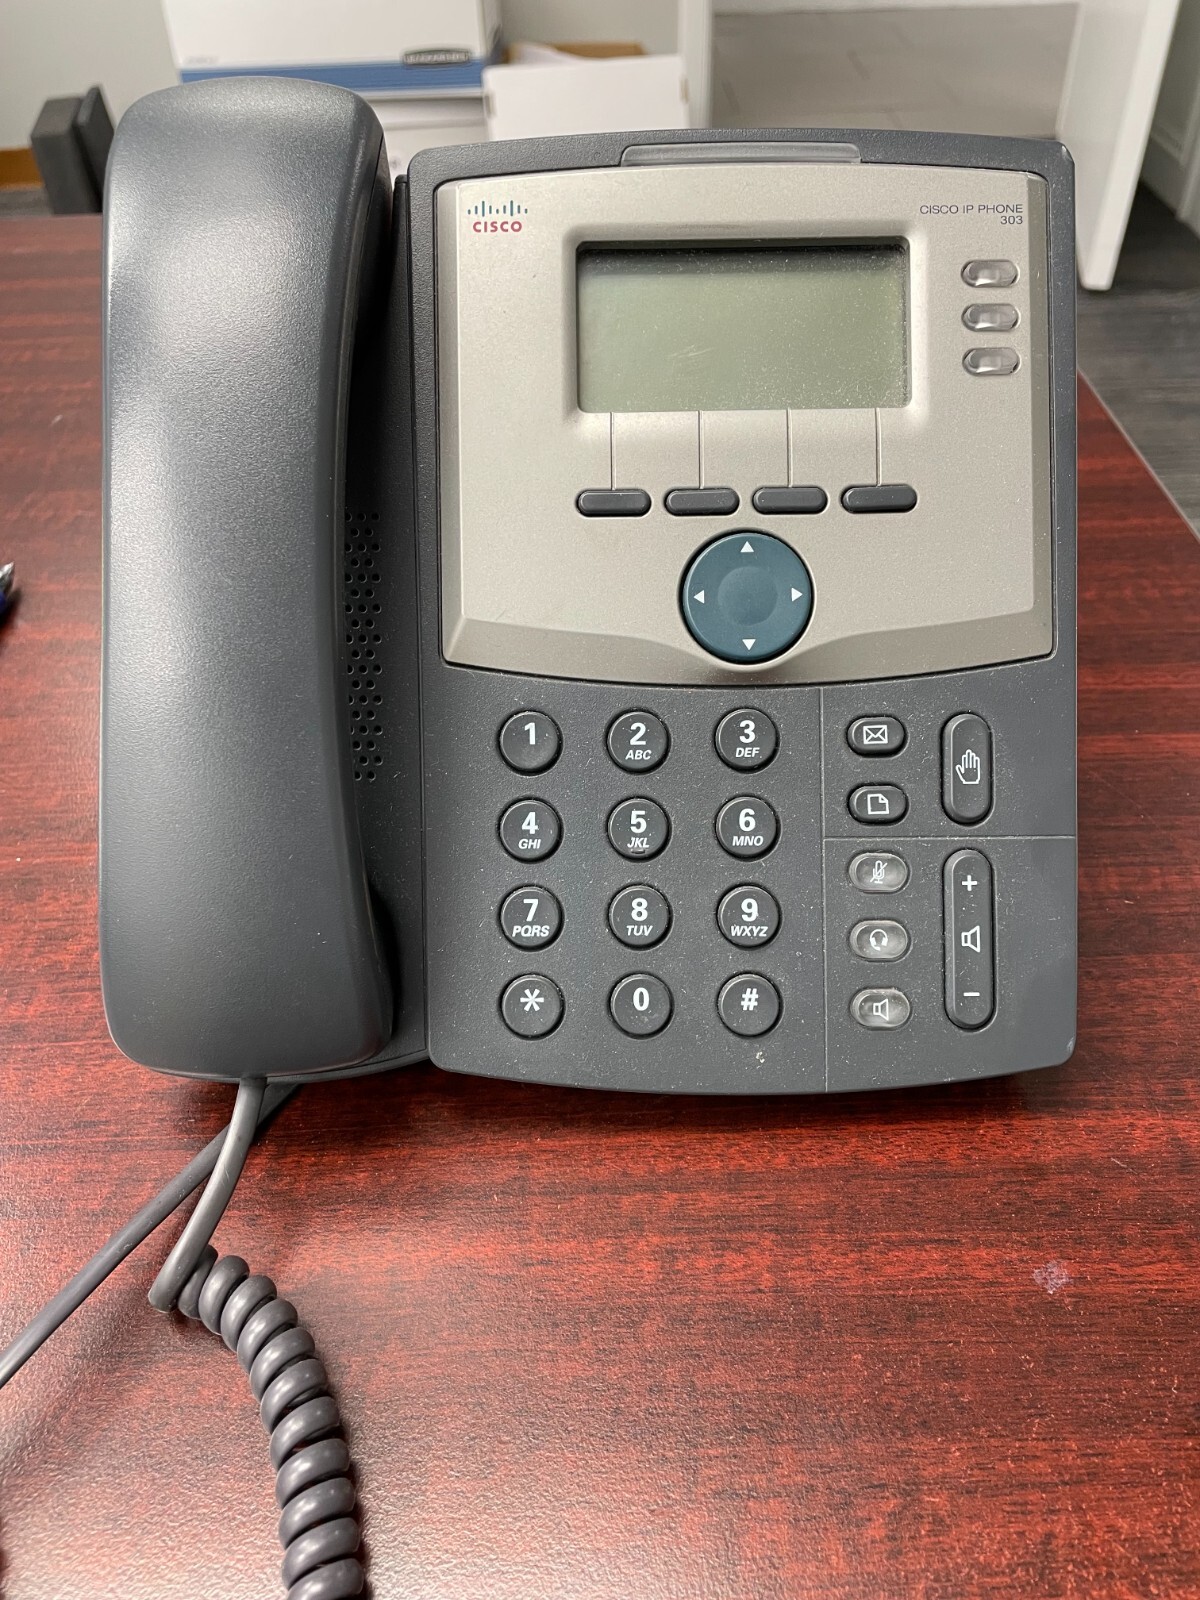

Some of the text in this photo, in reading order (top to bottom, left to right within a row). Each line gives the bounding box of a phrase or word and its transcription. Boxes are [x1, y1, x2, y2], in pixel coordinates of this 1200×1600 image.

[919, 203, 1023, 215] CISCO IP PHONE
[472, 220, 523, 233] CISCO
[1000, 215, 1023, 225] 303
[524, 722, 536, 745] 1
[629, 722, 647, 746] 2
[739, 720, 756, 744] 3
[625, 749, 652, 760] ABC
[735, 747, 760, 758] DEF
[521, 812, 539, 835] 4
[630, 810, 647, 834] 5
[738, 808, 756, 832] 6
[518, 838, 541, 850] GHI
[627, 837, 650, 848] JKL
[732, 835, 764, 847] MNO
[523, 898, 539, 922] 7
[631, 897, 648, 922] 8
[741, 898, 759, 922] 9
[512, 924, 550, 937] PQRS
[626, 924, 653, 936] TUV
[730, 924, 769, 937] WXYZ
[632, 987, 650, 1011] 0
